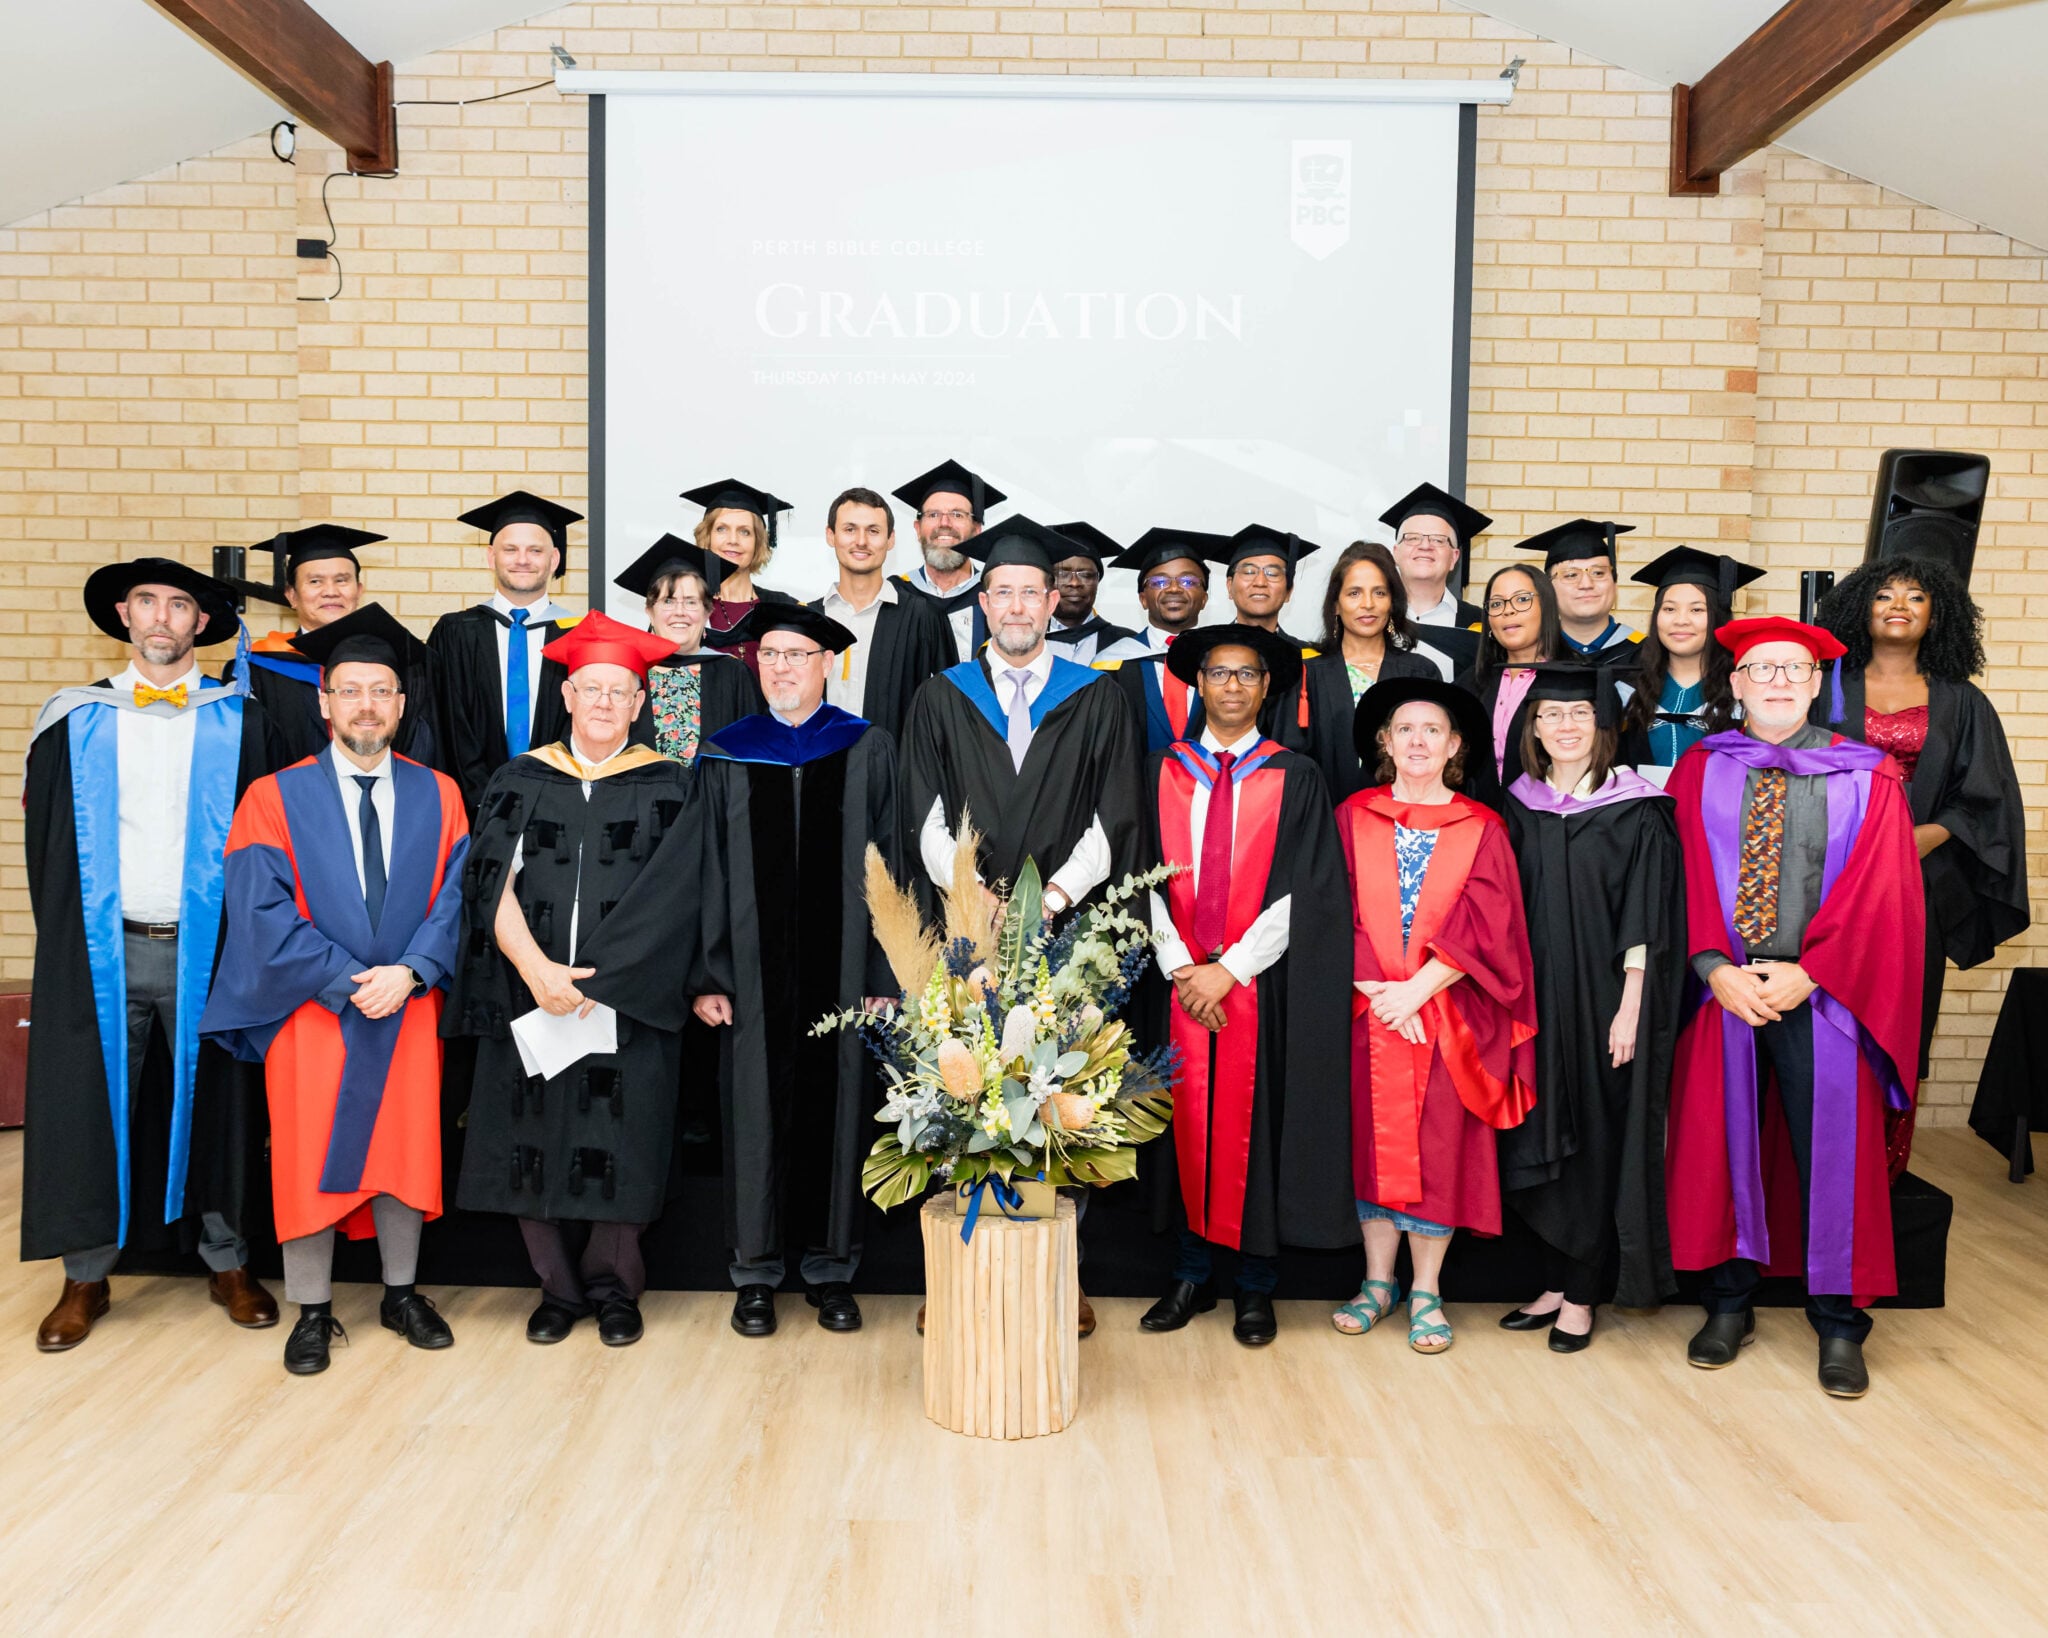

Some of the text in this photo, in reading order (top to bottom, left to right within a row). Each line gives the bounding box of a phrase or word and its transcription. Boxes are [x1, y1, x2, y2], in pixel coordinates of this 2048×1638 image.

[1296, 205, 1346, 225] PBC
[752, 240, 984, 256] PERTH BIBLE COLLEGE
[755, 282, 1244, 341] GRADUATION
[752, 370, 976, 386] THURSDAY 16TH MAY 2024
